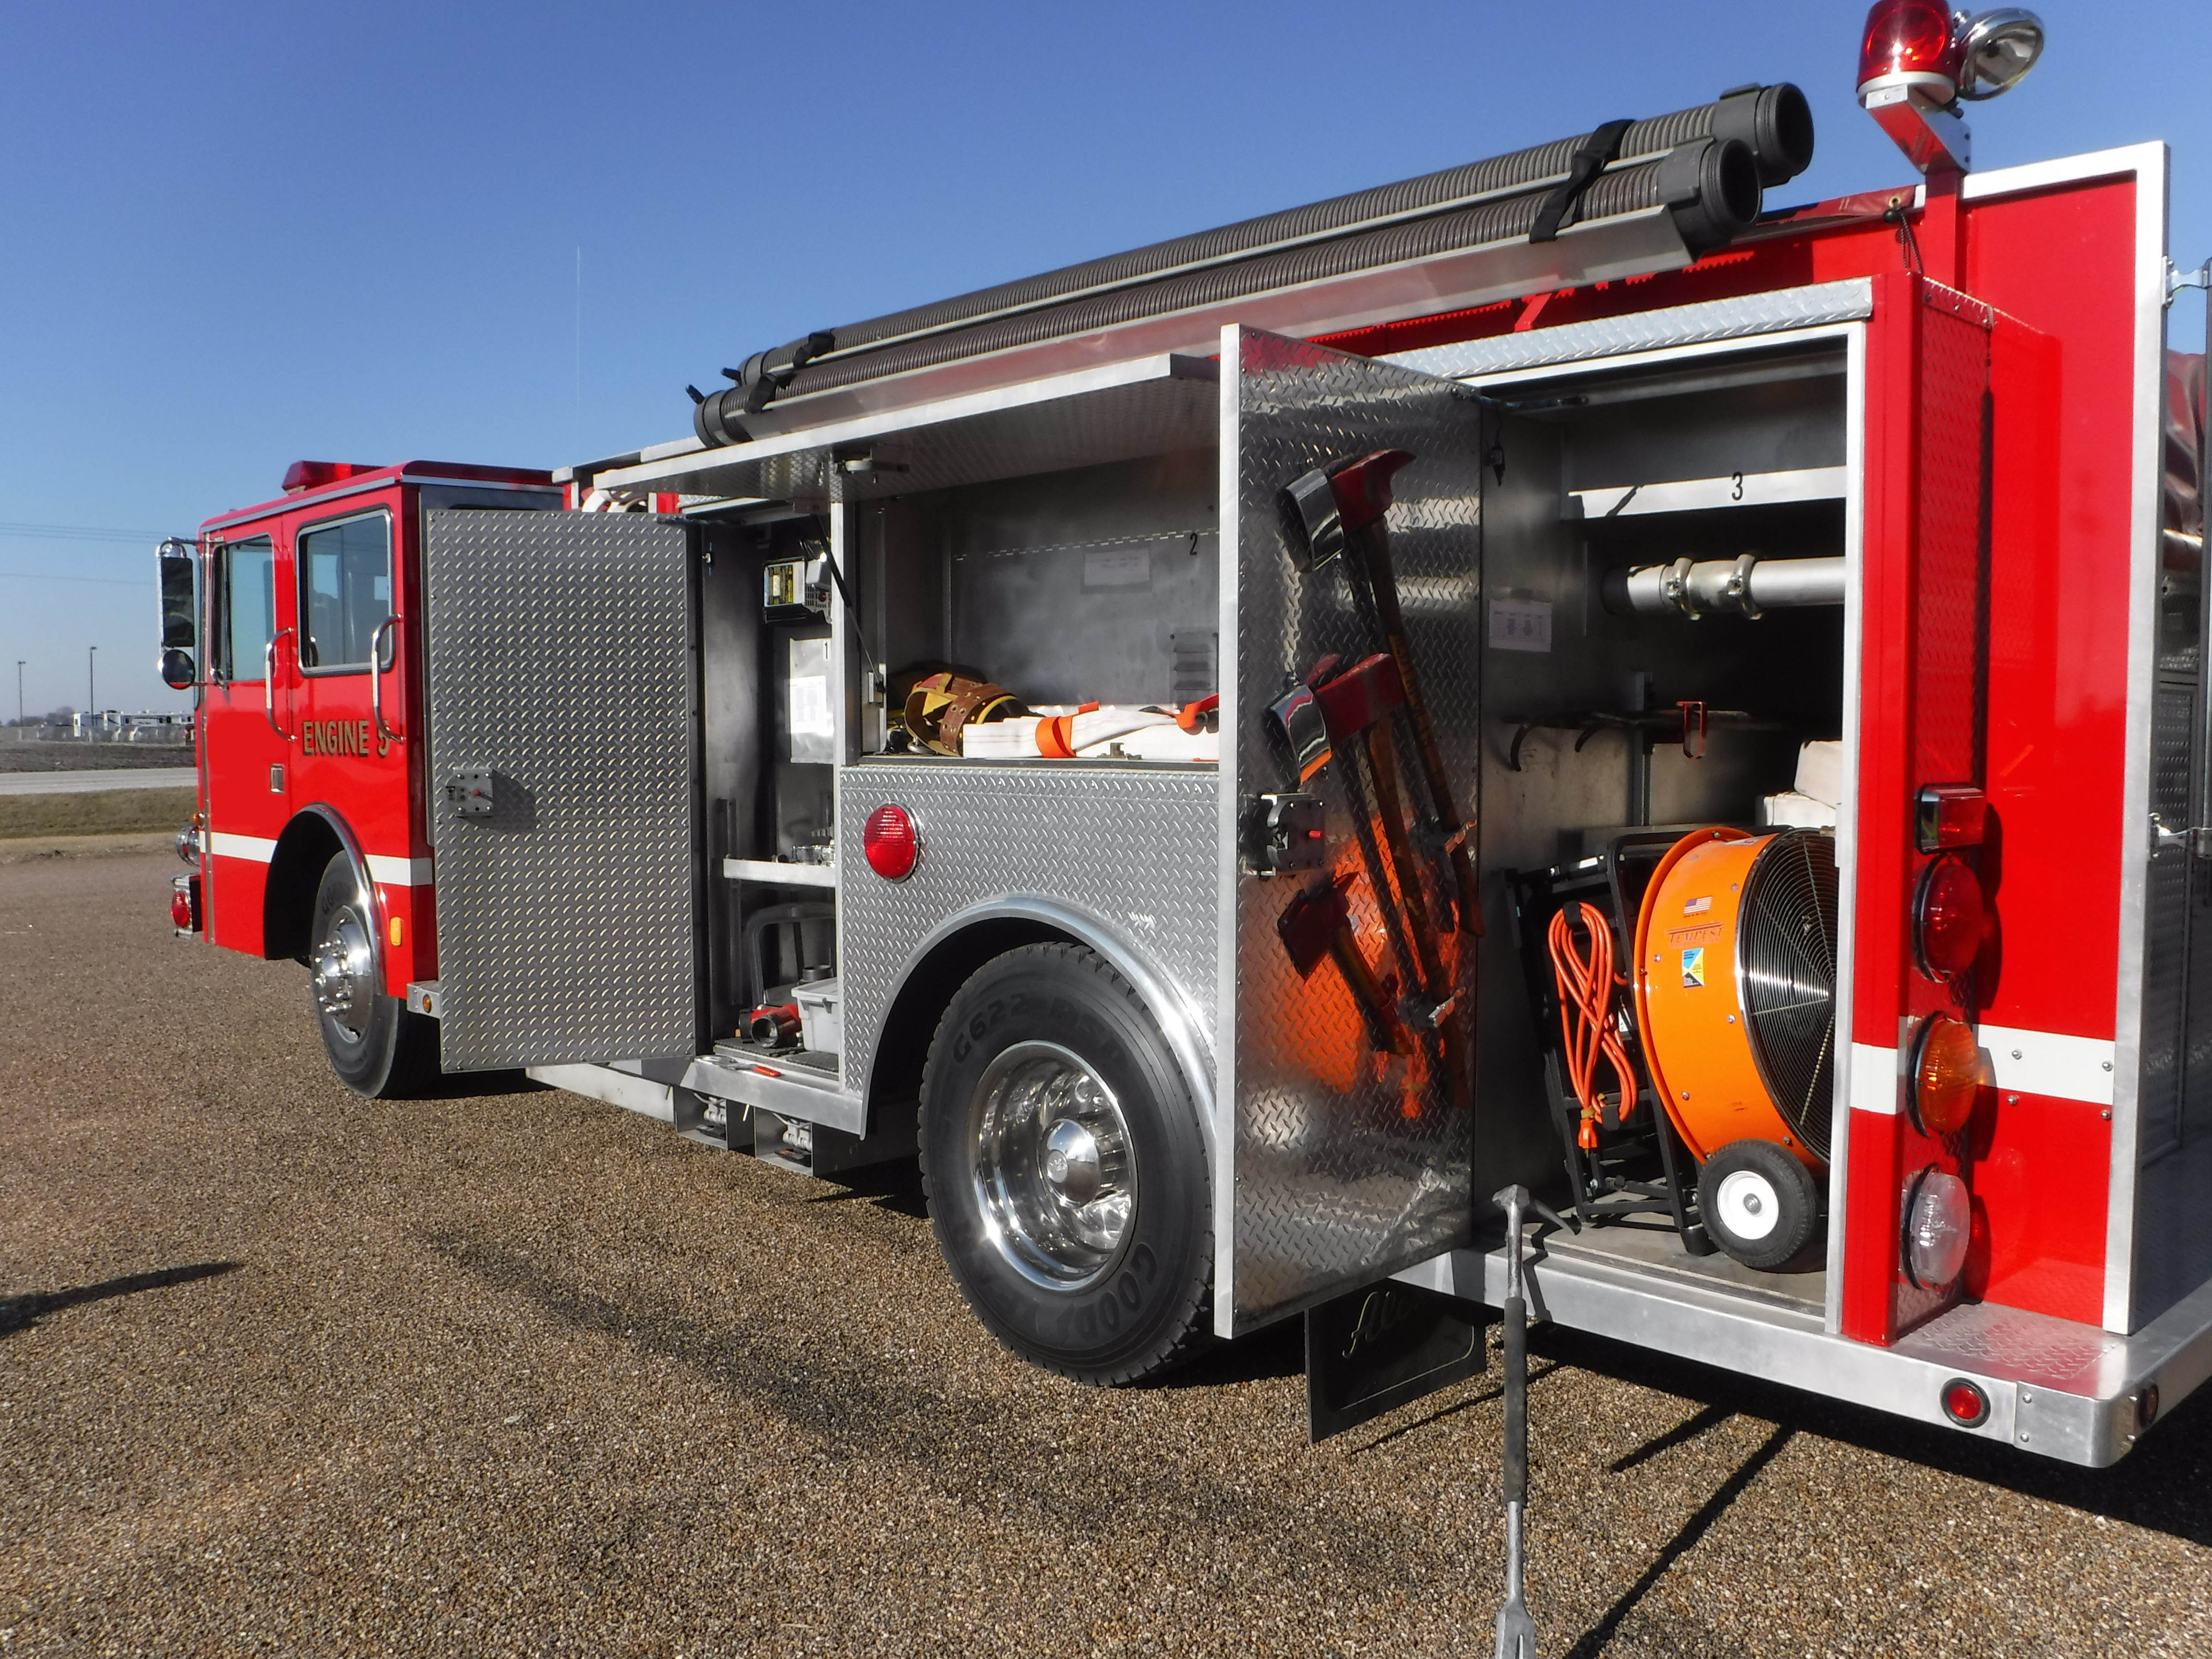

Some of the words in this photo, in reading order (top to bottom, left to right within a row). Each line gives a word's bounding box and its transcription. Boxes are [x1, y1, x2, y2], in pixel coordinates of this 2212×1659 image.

[1731, 471, 1743, 501] 3
[1189, 532, 1198, 556] 2
[303, 720, 369, 757] ENGINE
[953, 992, 1030, 1064] G622
